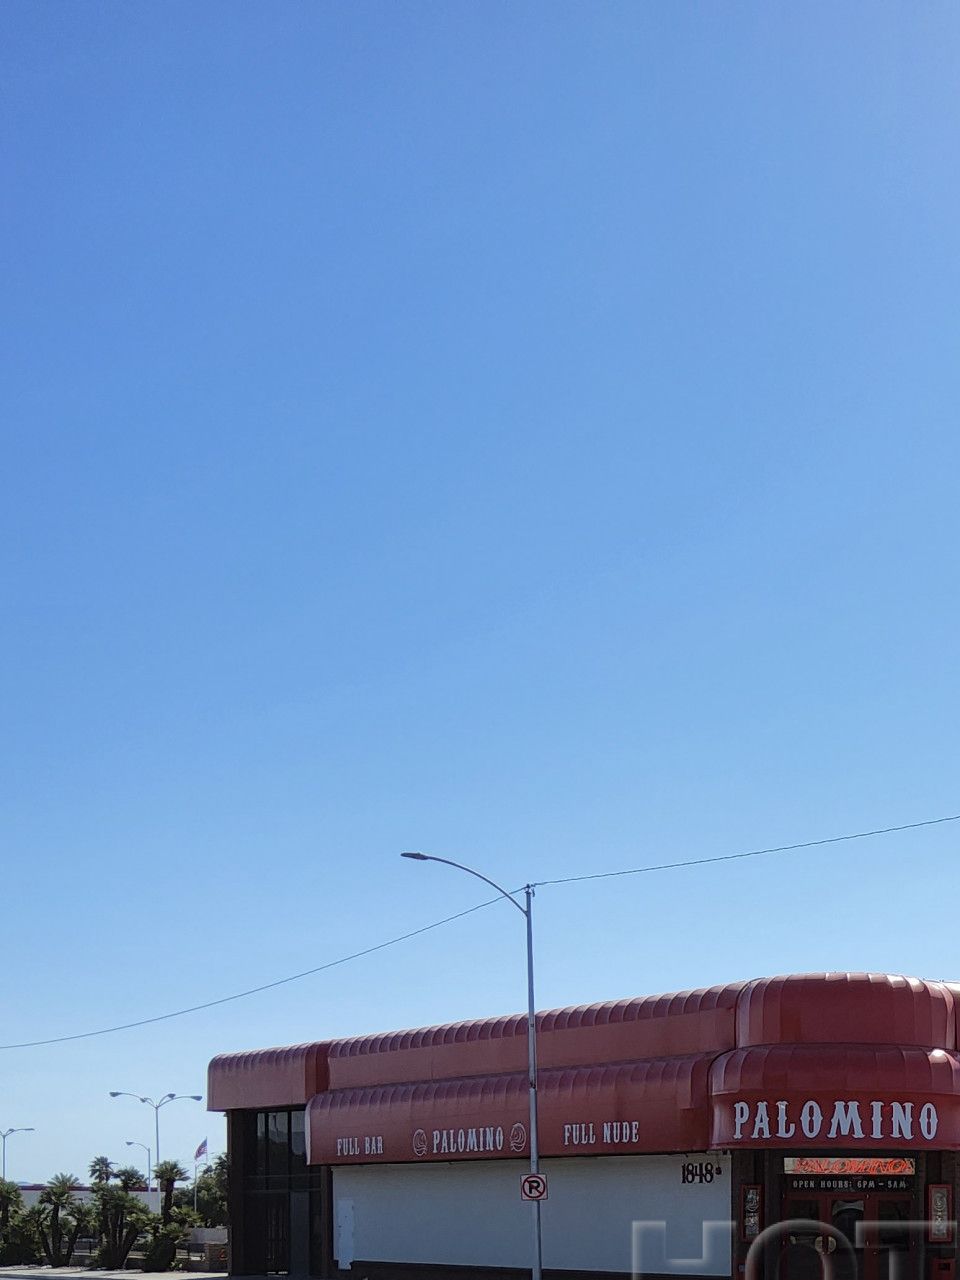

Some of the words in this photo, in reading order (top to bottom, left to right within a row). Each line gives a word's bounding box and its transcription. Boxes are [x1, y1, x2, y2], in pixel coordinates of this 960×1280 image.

[733, 1100, 938, 1140] PALOMINO
[432, 1126, 504, 1154] PALOMINO
[564, 1123, 596, 1145] FULL
[602, 1121, 640, 1143] NUDE
[336, 1137, 360, 1156] FULL
[364, 1136, 384, 1155] BAR
[681, 1162, 714, 1184] 1848
[792, 1180, 815, 1189] OPEN
